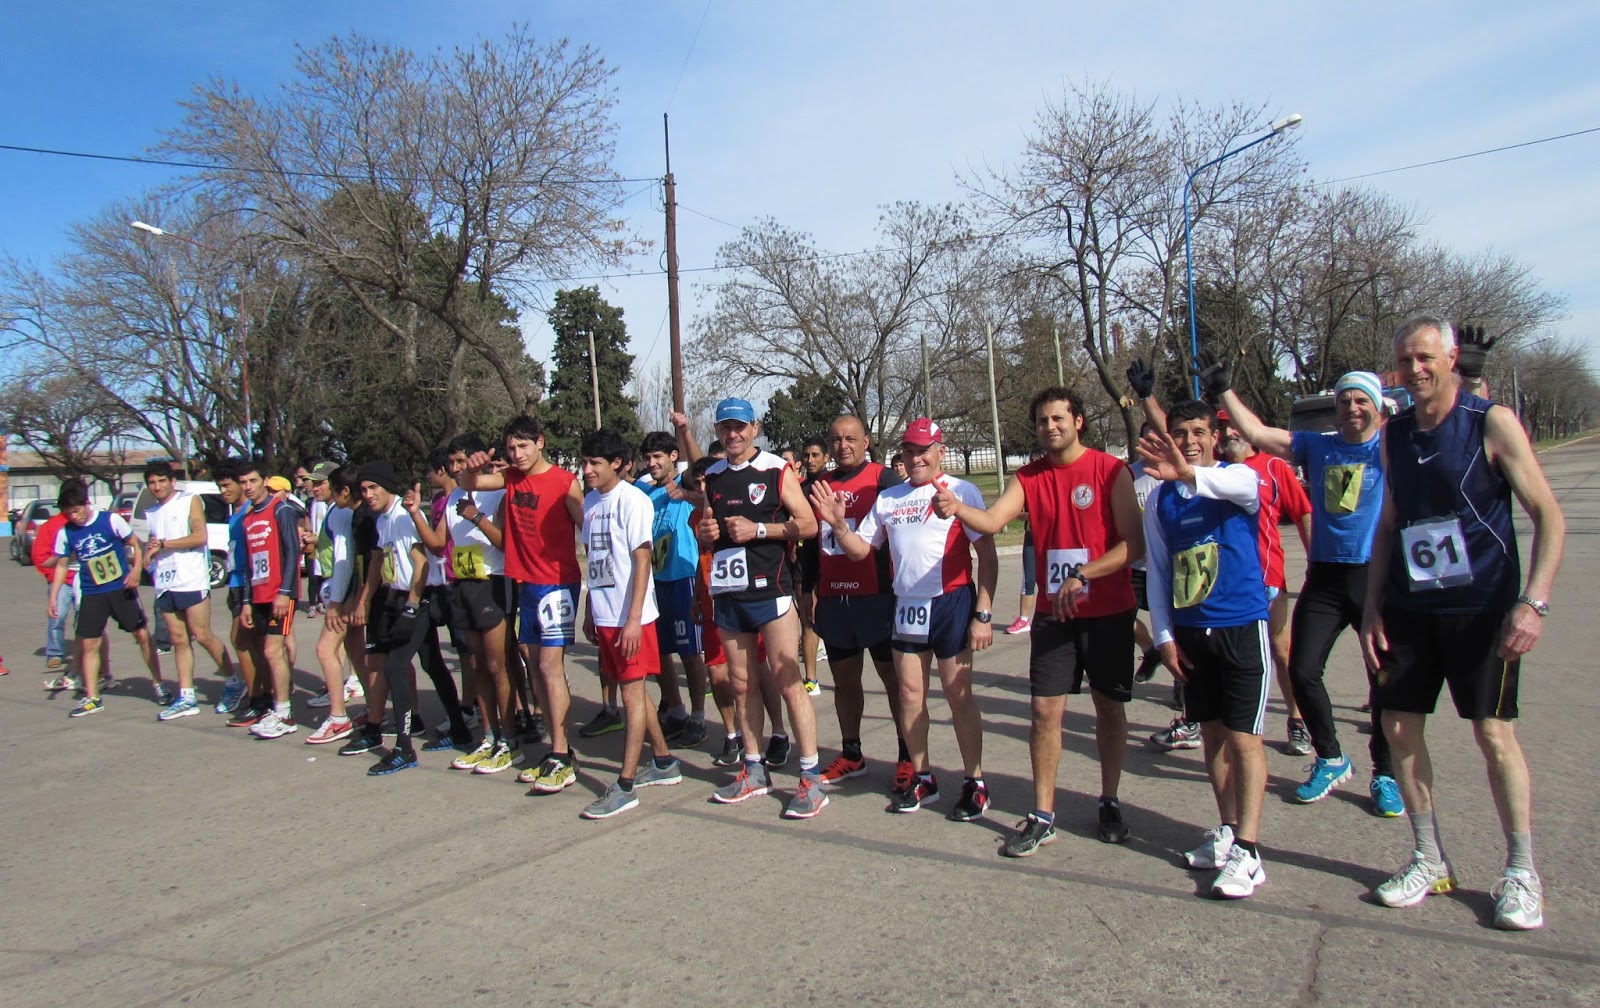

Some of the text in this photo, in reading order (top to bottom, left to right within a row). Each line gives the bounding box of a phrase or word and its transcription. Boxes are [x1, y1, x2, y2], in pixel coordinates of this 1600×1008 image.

[893, 507, 918, 516] RIVER
[1411, 535, 1459, 568] 61
[96, 556, 117, 579] 95
[160, 570, 177, 583] 197
[714, 558, 745, 579] 56
[1050, 562, 1084, 584] 20
[830, 582, 859, 590] RUFINO
[542, 599, 571, 621] 15
[899, 606, 928, 625] 109
